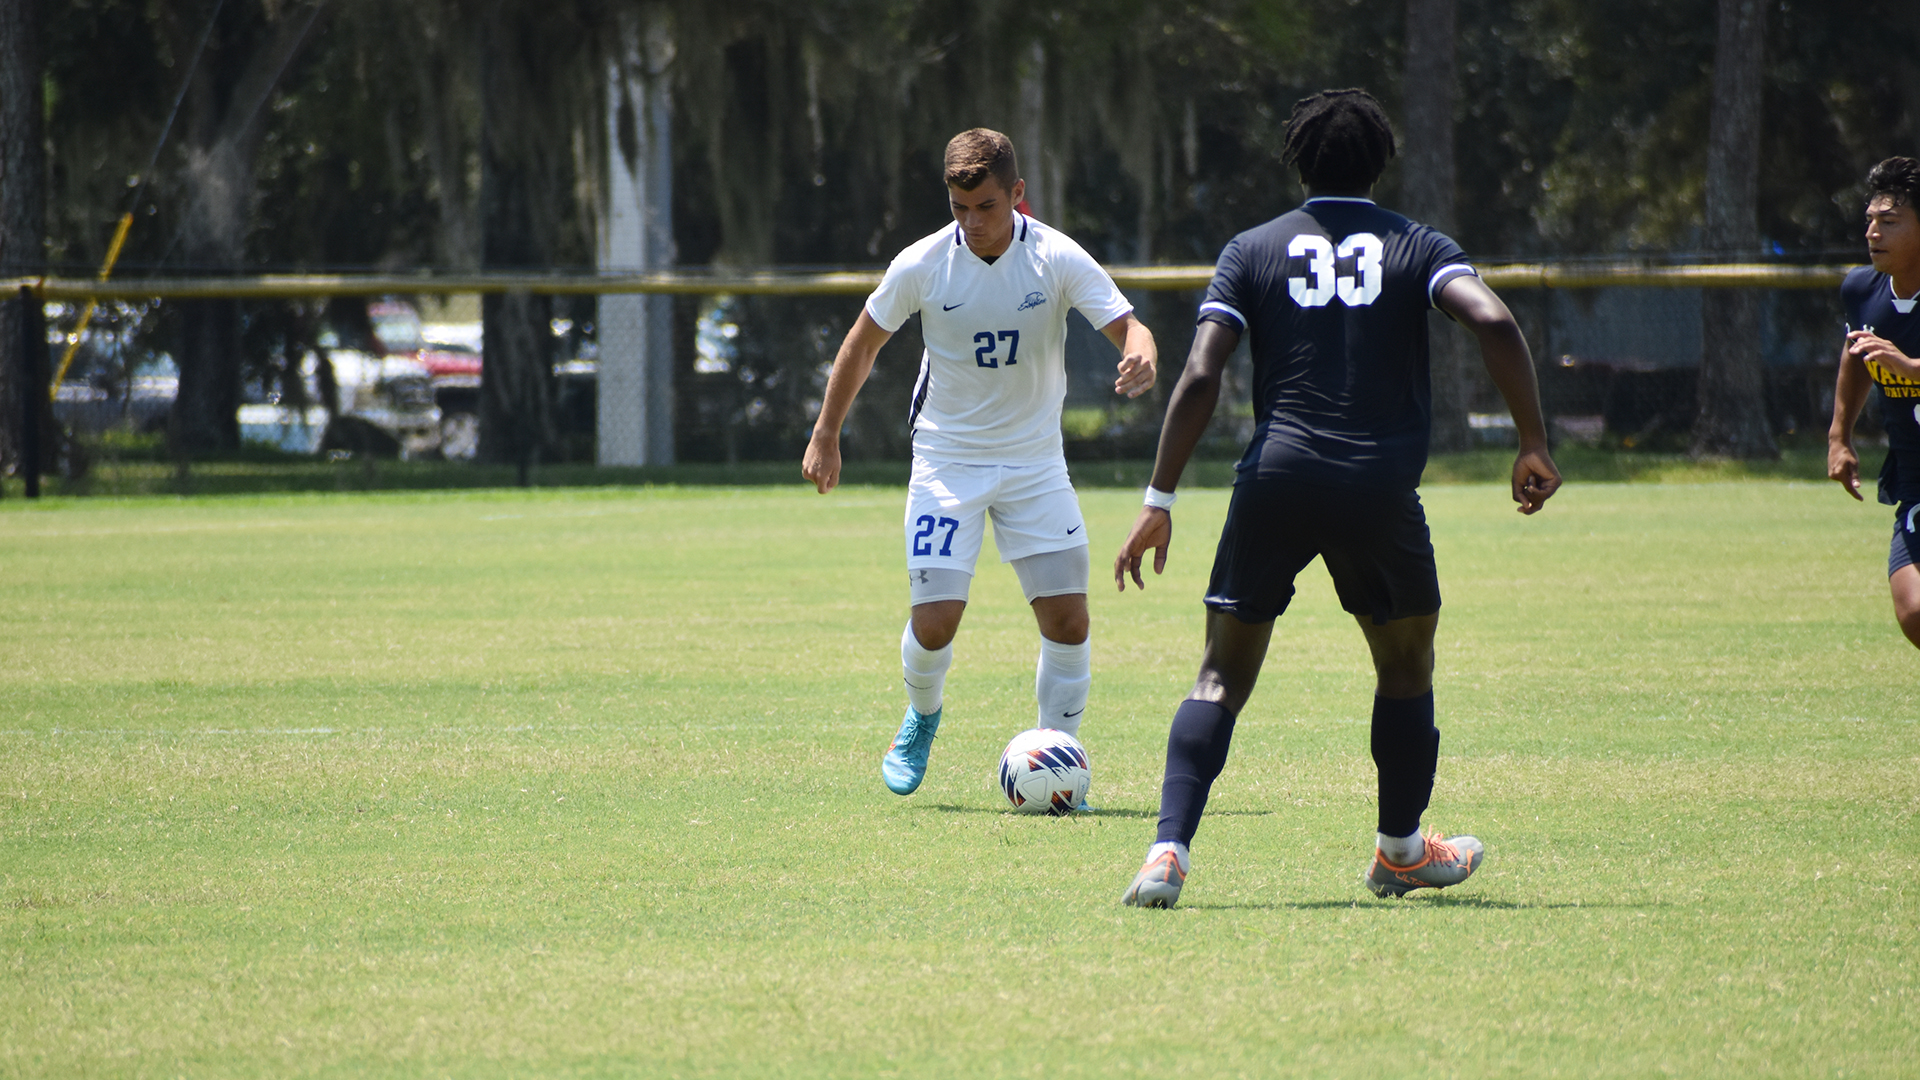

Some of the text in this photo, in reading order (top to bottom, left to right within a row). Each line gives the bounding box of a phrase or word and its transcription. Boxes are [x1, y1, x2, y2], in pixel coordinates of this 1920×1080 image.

[1288, 232, 1384, 307] 33
[973, 330, 1020, 368] 27
[913, 515, 959, 556] 27
